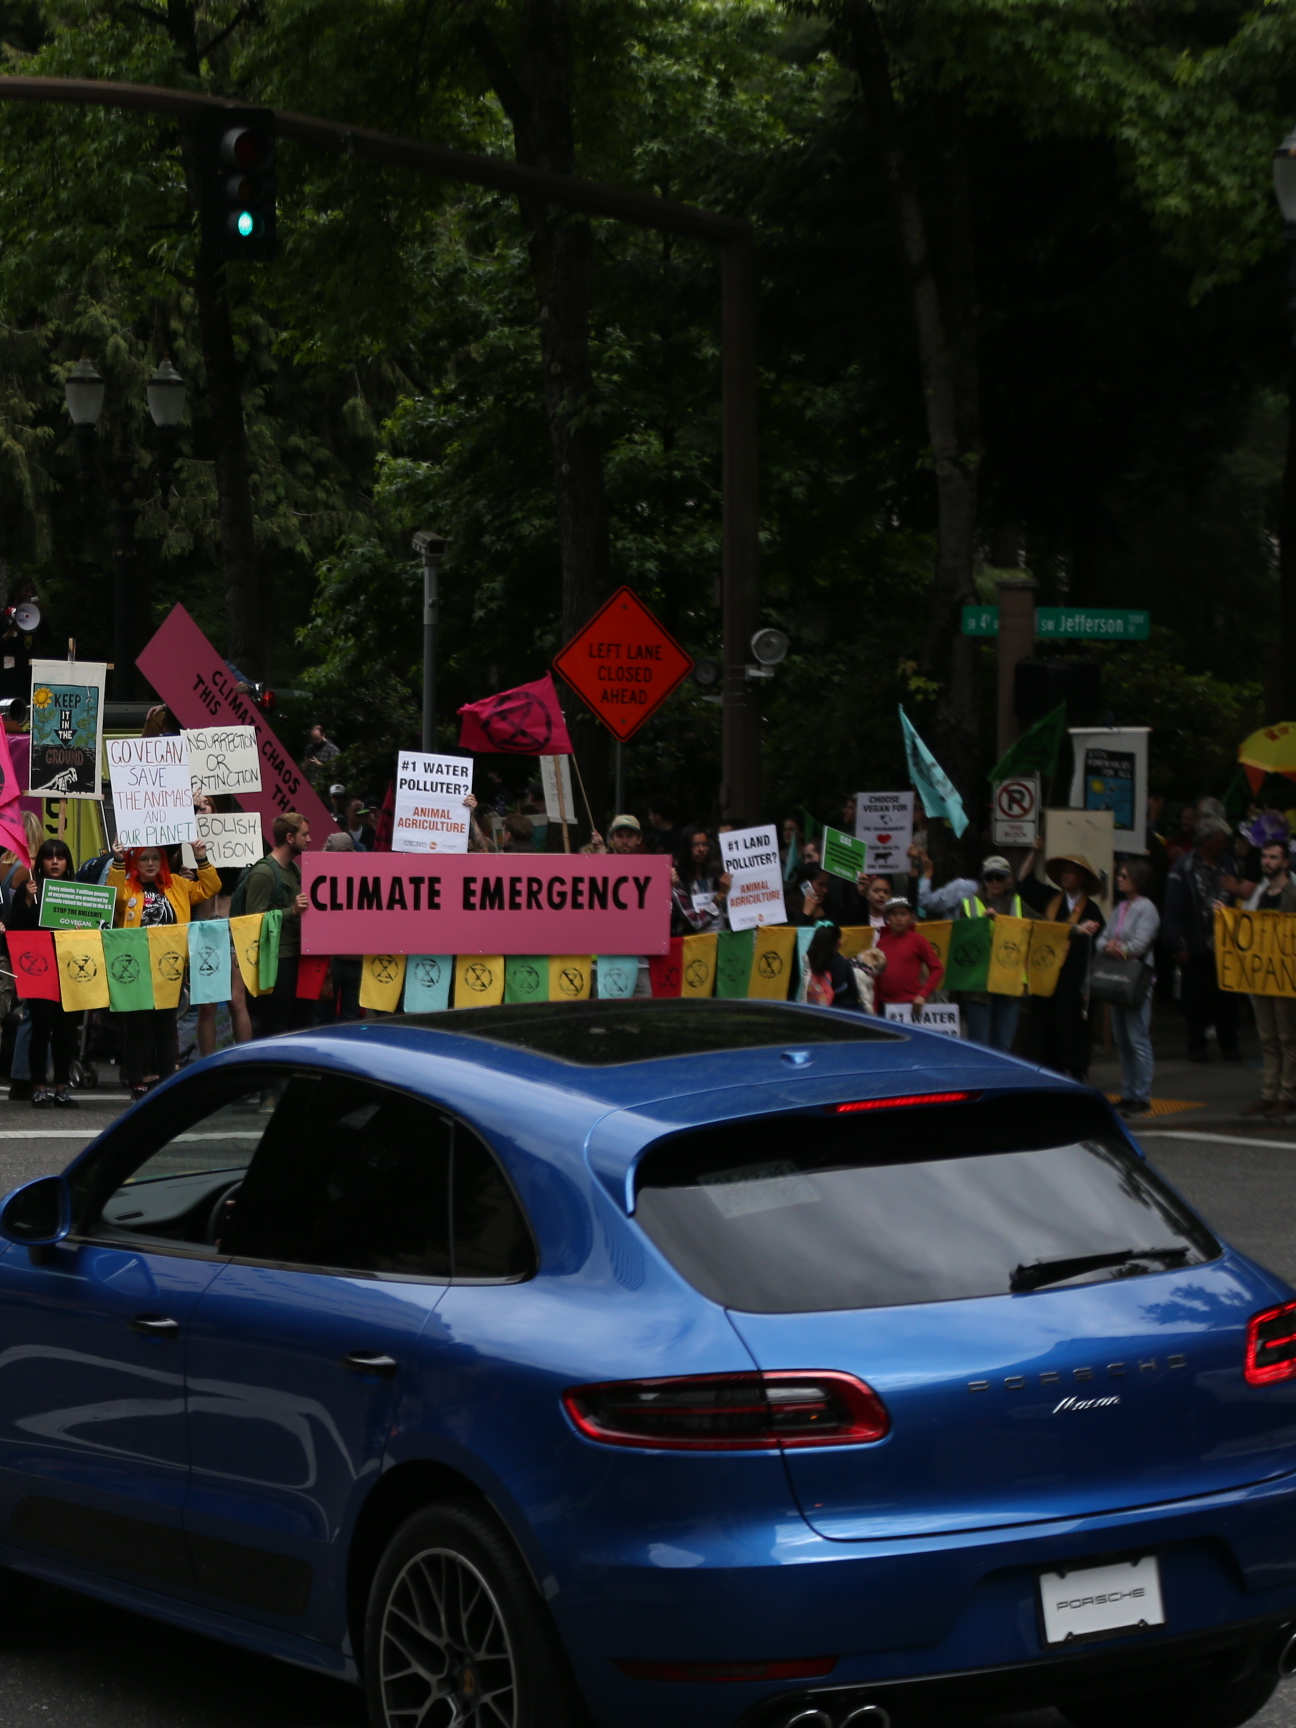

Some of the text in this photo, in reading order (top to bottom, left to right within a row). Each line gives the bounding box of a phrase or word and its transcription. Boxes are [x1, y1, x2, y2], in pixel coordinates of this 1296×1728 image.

[1040, 619, 1055, 631] SW
[1059, 614, 1124, 633] Jefferson
[589, 643, 662, 661] LEFT LANE
[598, 666, 652, 683] CLOSED
[54, 693, 81, 709] KEEP
[192, 674, 221, 715] THIS
[601, 689, 648, 705] AHEAD
[62, 711, 70, 720] IT
[62, 721, 70, 729] IN
[58, 730, 73, 740] THE
[45, 750, 84, 766] GROUND
[110, 740, 184, 764] GO VEGAN
[206, 754, 231, 773] OR
[262, 740, 301, 795] CHAOS
[402, 761, 469, 778] #1 WATER
[128, 768, 166, 788] SAVE
[399, 778, 469, 796] POLLUTER?
[114, 789, 193, 810] THE ANIMALS
[143, 810, 166, 824] AND
[413, 807, 452, 820] ANIMAL
[119, 822, 194, 846] OUR PLANET
[197, 817, 257, 838] BOLISH
[397, 817, 466, 833] AGRICULTURE
[206, 841, 255, 861] RISON
[727, 835, 770, 852] #1 LAND
[725, 852, 777, 871] POLLUTER?
[310, 876, 652, 911] CLIMATE EMERGENCY
[741, 881, 770, 894] ANIMAL
[730, 890, 781, 908] AGRICULTURE
[1221, 913, 1253, 951] NO
[911, 1012, 956, 1024] WATER
[968, 1353, 1187, 1393] PORSCHE
[1051, 1395, 1122, 1415] Macan
[1056, 1587, 1146, 1612] PORSCHE
